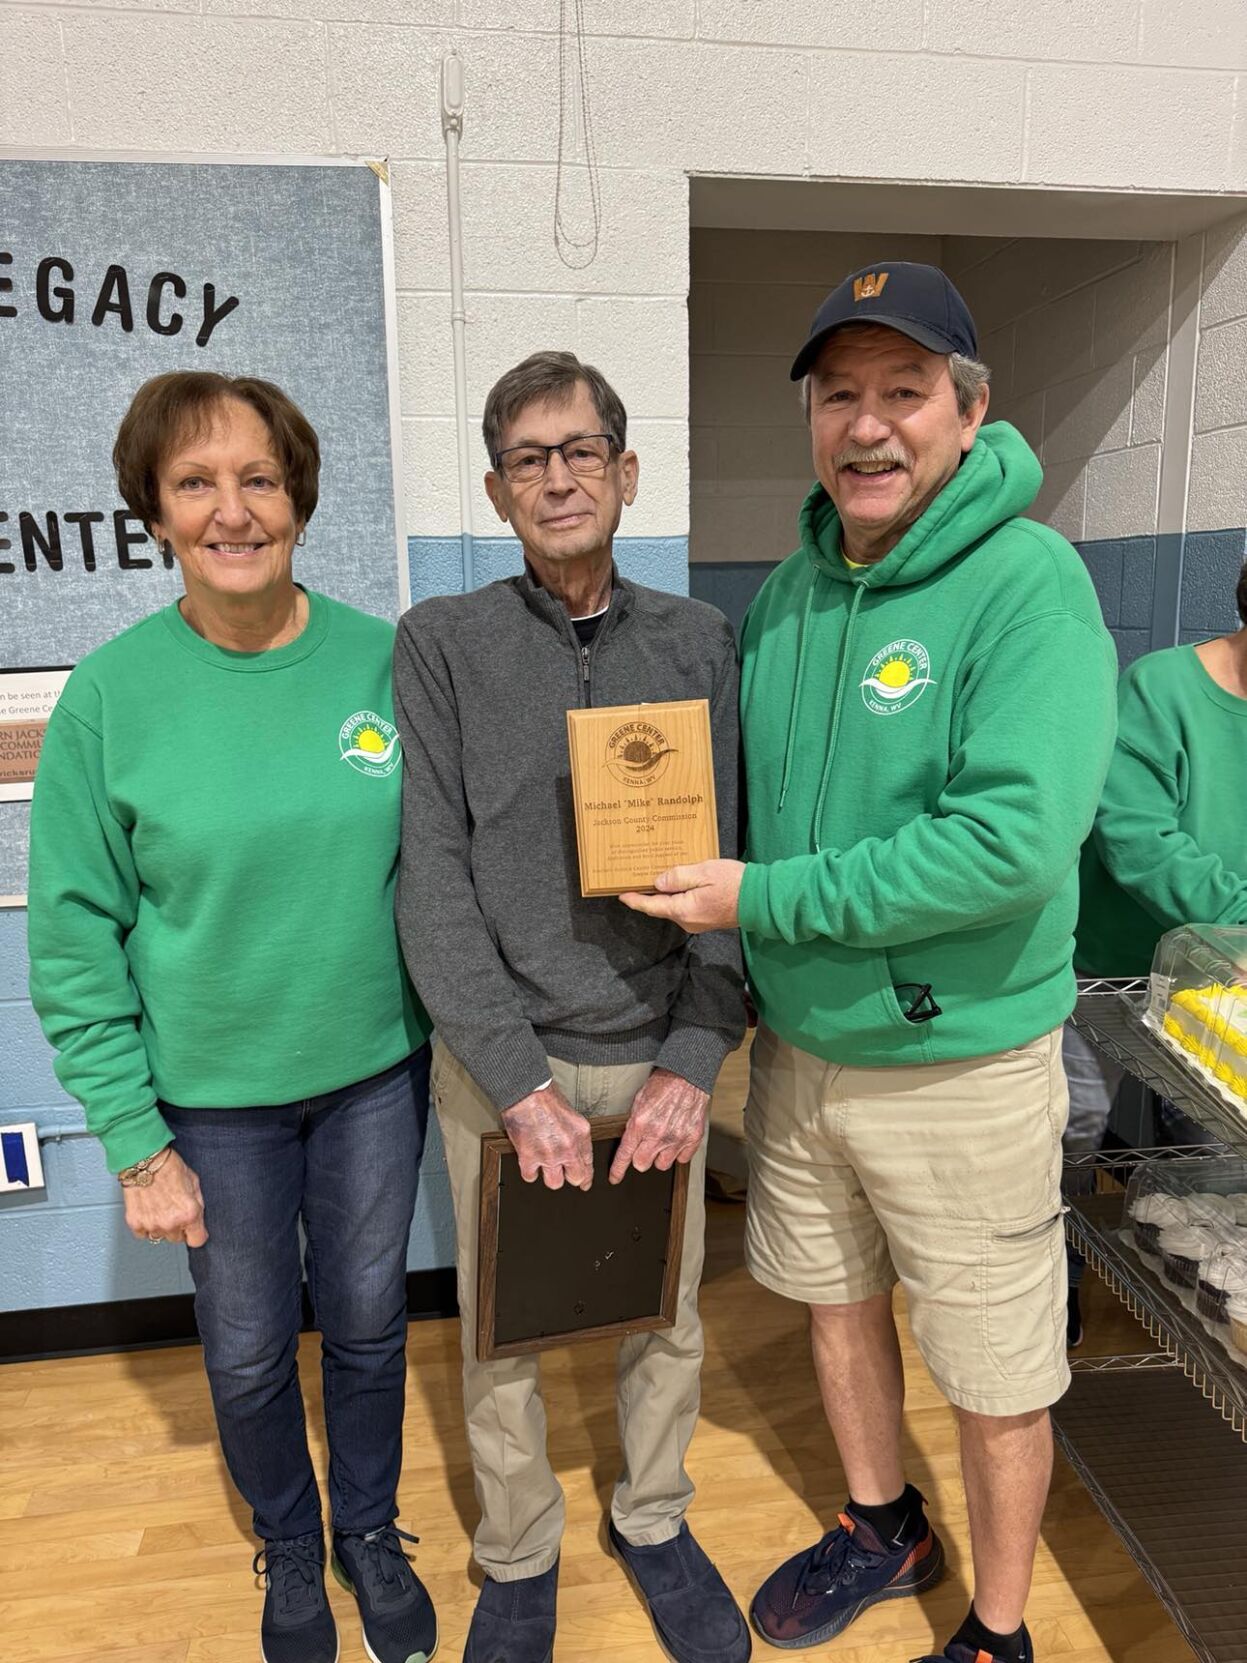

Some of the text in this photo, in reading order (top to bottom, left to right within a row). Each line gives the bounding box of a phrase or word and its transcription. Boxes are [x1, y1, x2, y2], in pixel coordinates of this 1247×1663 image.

[853, 272, 889, 302] W
[872, 641, 928, 670] GREENE CENTER
[8, 706, 41, 714] Greene
[341, 713, 393, 740] GREENE CENTER
[608, 723, 665, 748] GREENE CENTER
[584, 800, 621, 811] Michael
[657, 794, 704, 806] Randolph
[593, 812, 697, 826] Jackson County Commission
[636, 825, 655, 833] 2024
